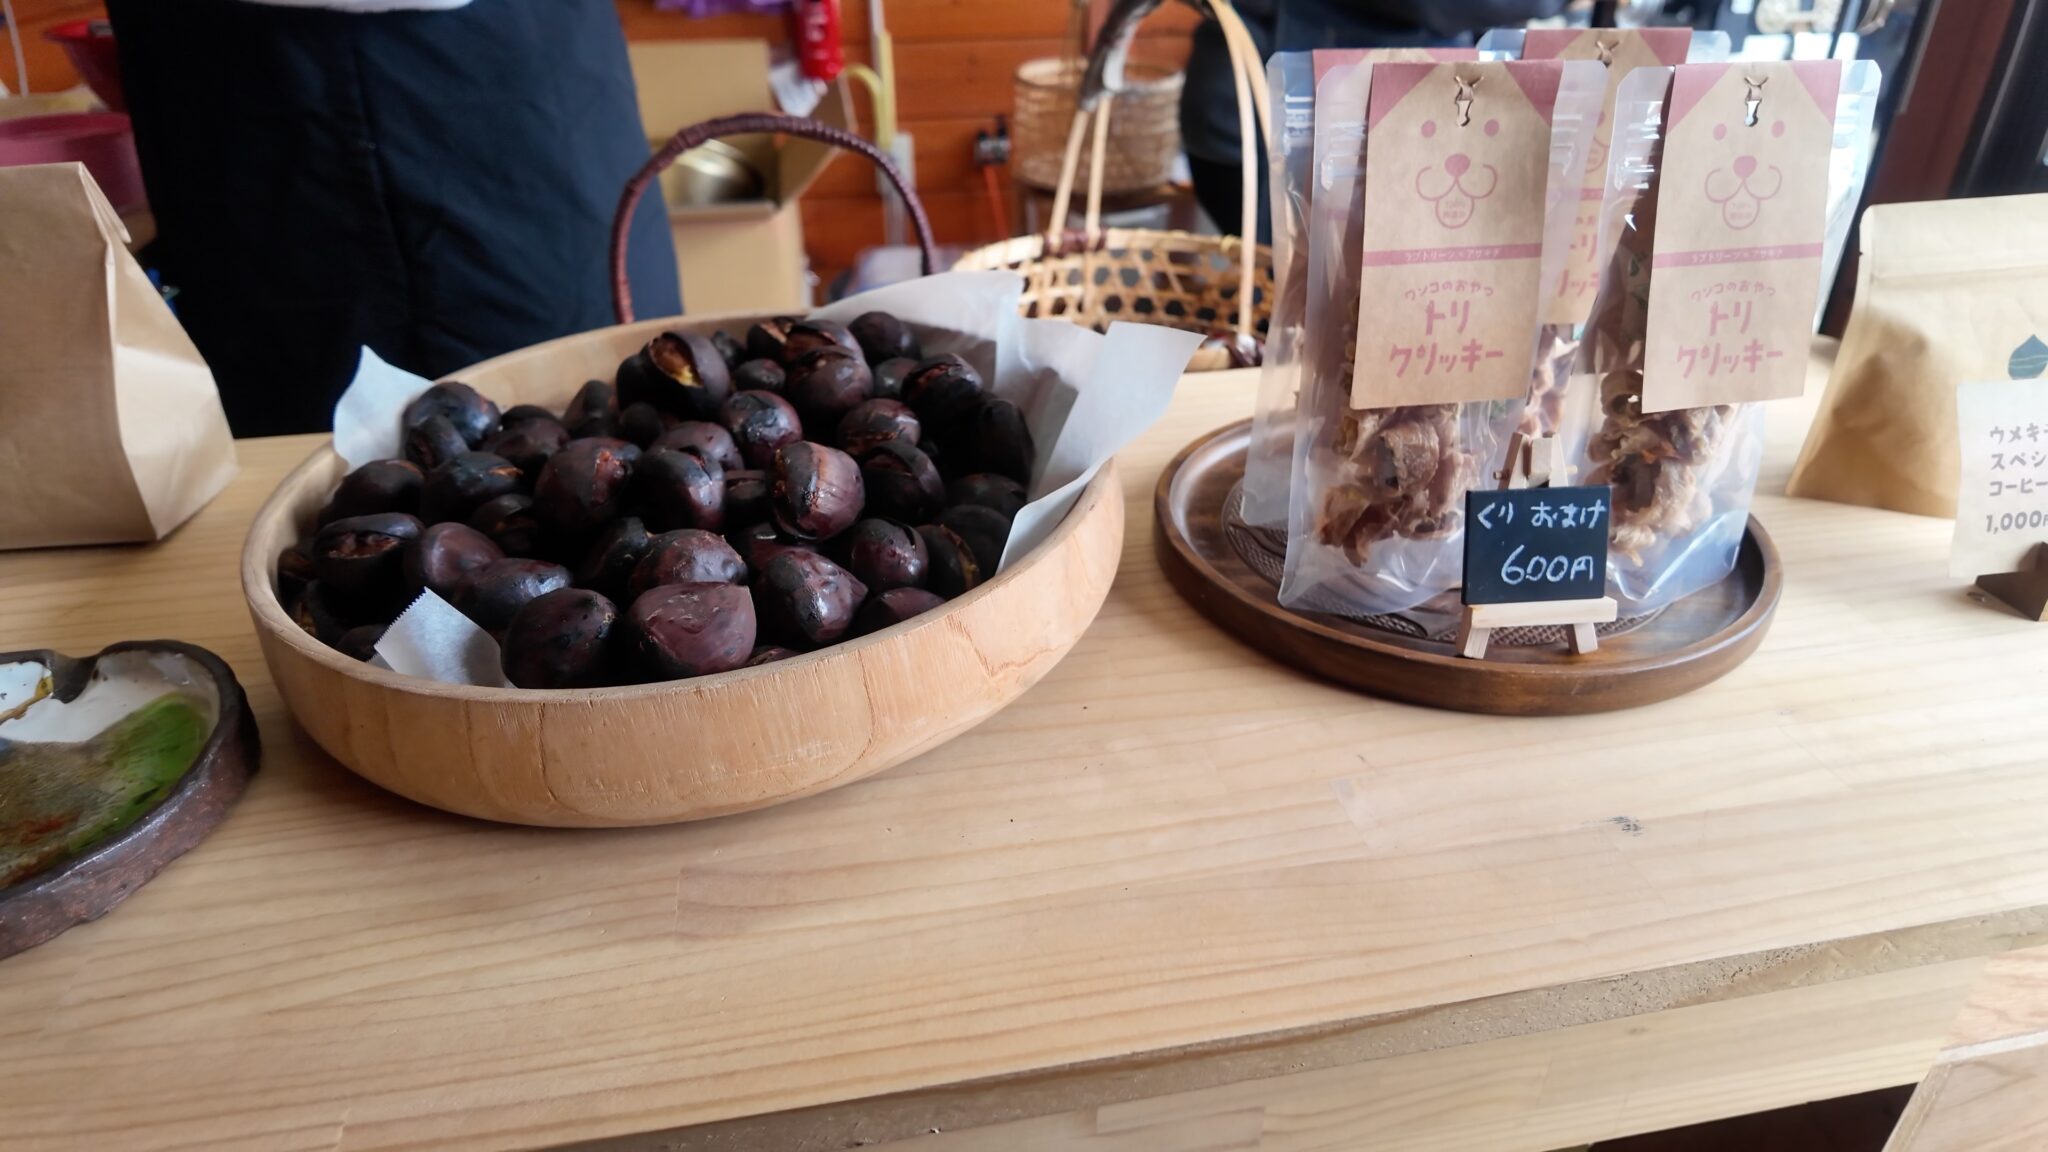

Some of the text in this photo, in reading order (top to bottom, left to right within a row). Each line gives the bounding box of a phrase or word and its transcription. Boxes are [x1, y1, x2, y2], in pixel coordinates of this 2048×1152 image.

[1404, 279, 1494, 300] ワンコのおやつ
[1690, 280, 1777, 300] ワンコのおやつ
[1425, 300, 1470, 336] トリ
[1709, 300, 1753, 336] トリ
[1389, 338, 1504, 378] クリッキー
[1676, 338, 1784, 379] クリッキー
[1988, 478, 2048, 497] コーヒー
[1477, 498, 1607, 530] くり おまけ
[1500, 544, 1594, 585] 600円
